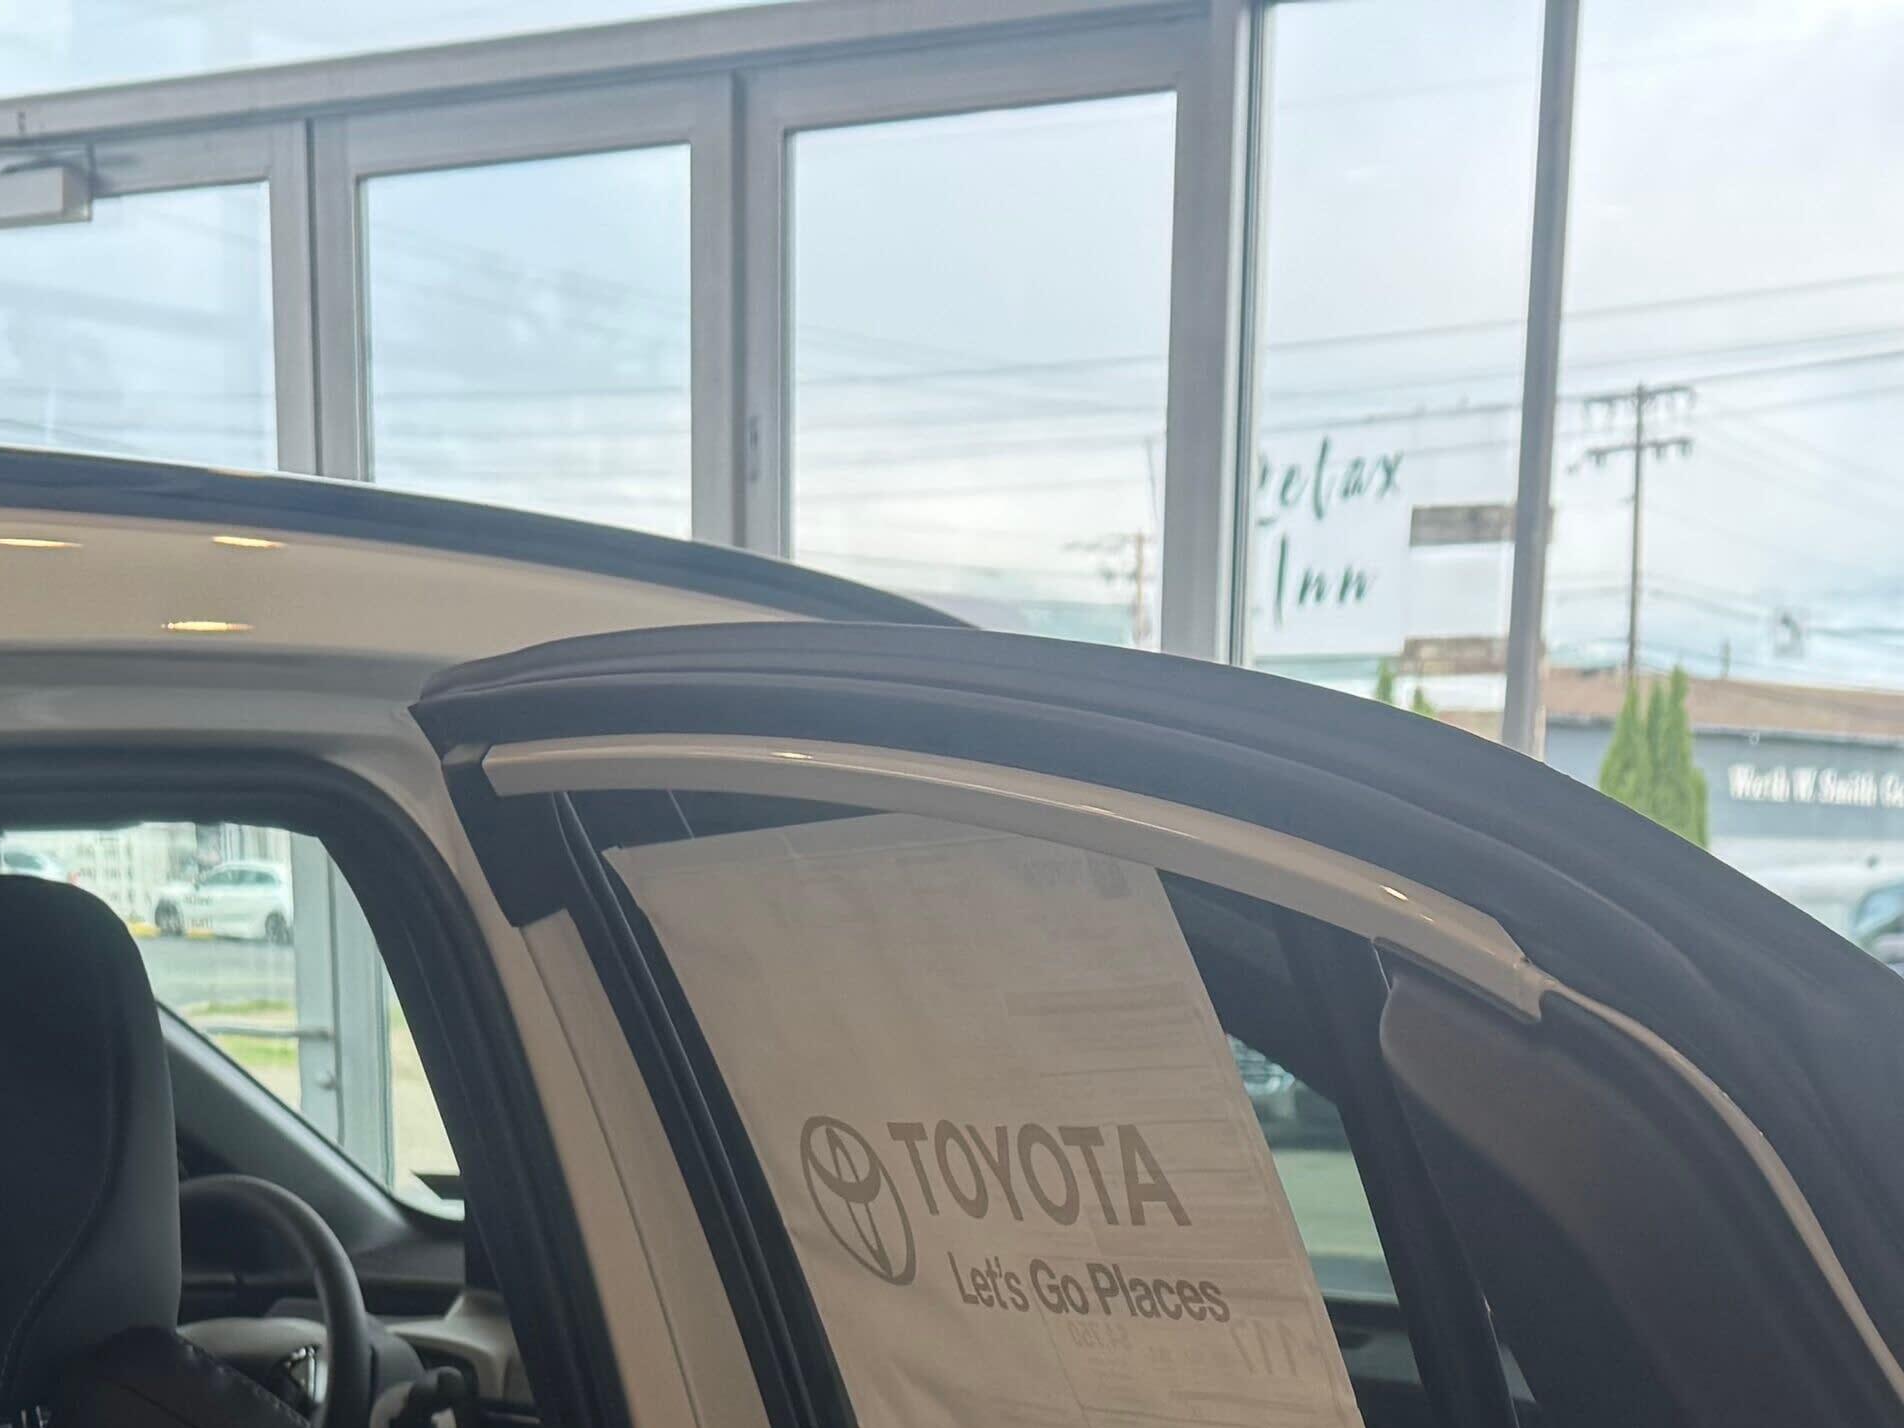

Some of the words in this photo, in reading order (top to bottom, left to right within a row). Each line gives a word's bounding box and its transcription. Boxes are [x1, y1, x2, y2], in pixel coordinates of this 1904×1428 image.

[1272, 536, 1377, 626] Inn
[1819, 768, 1877, 807] Smith
[887, 1119, 1191, 1226] TOYOTA
[947, 1251, 1030, 1312] Let's
[1028, 1258, 1089, 1315] Go
[1086, 1263, 1231, 1323] Places
